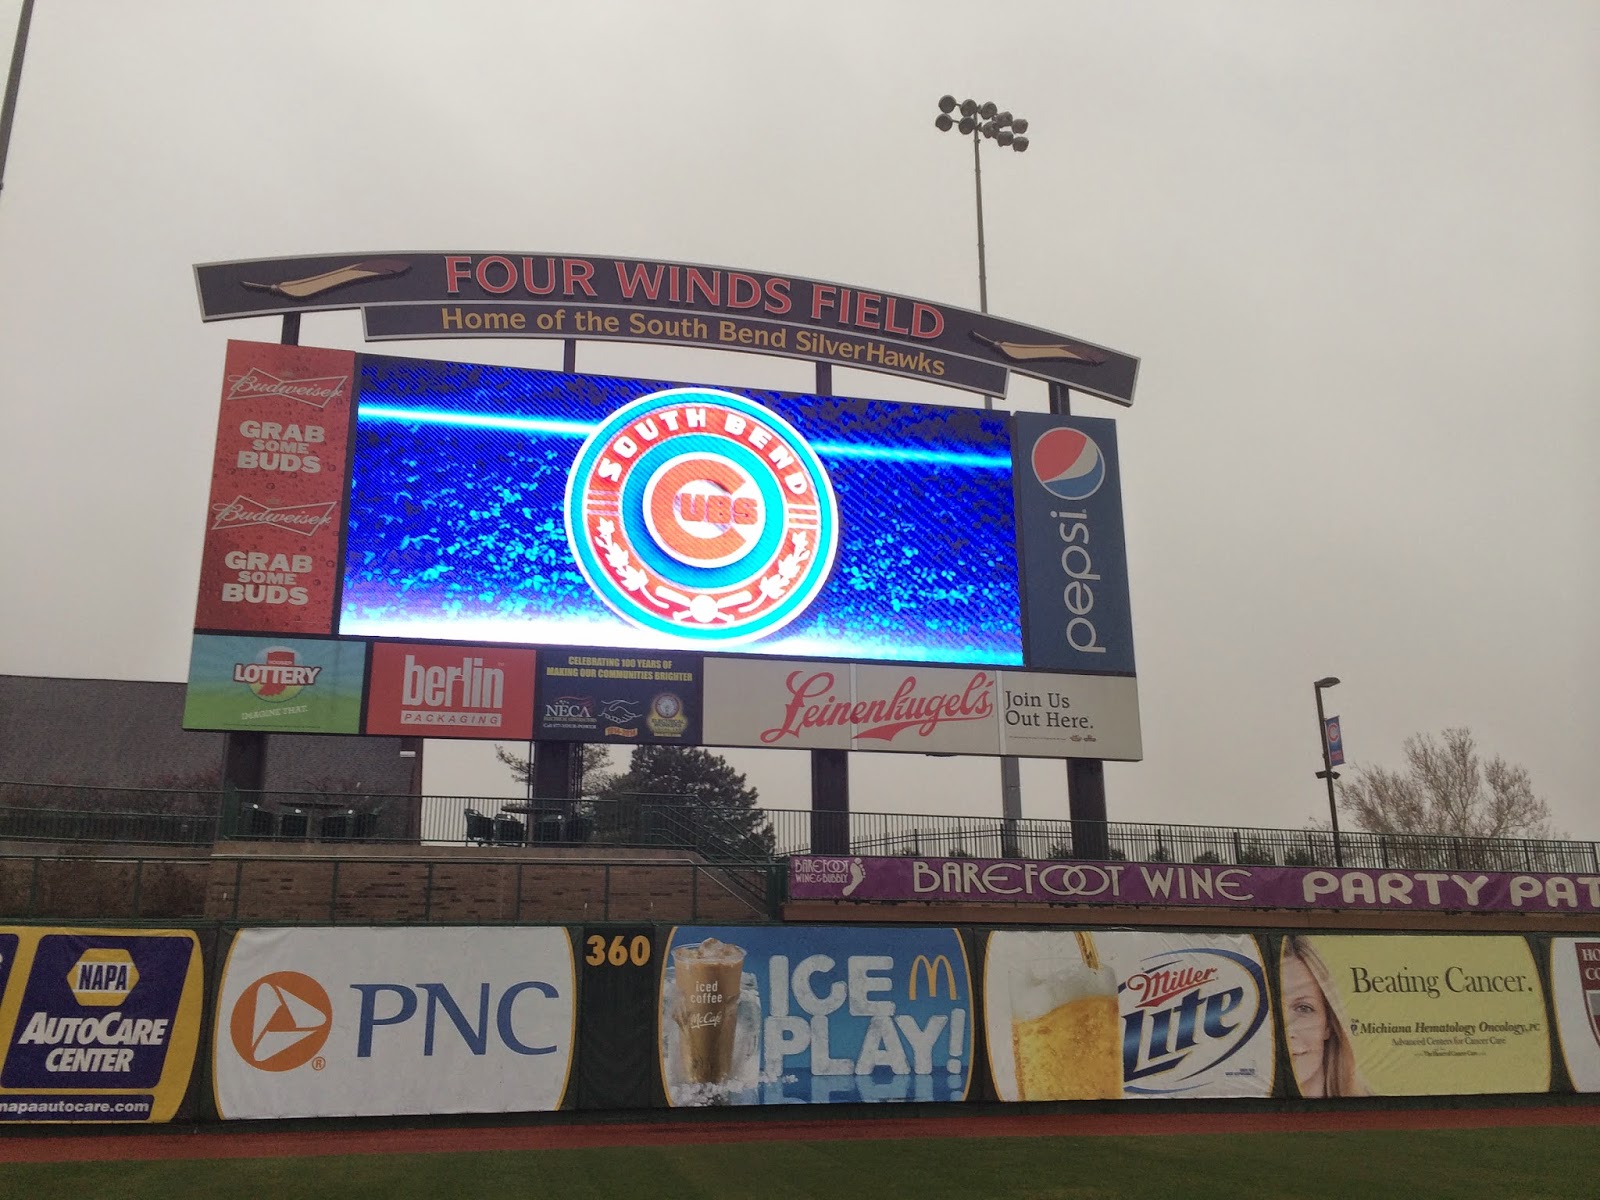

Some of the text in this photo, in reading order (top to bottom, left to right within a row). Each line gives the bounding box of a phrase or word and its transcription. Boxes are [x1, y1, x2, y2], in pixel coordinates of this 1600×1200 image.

[444, 255, 945, 339] FOUR WINDS FIELD
[441, 307, 945, 376] Home of the South Bend SilverHawks
[228, 375, 343, 398] Budweiser
[239, 420, 325, 443] GRAB
[252, 439, 309, 454] SOME
[597, 408, 808, 495] SOUTH BEND
[237, 451, 321, 474] BUDS
[212, 503, 331, 525] Budweiser
[224, 551, 313, 573] GRAB
[237, 571, 296, 586] SOME
[1050, 510, 1106, 653] pepsi
[221, 583, 309, 606] BUDS
[547, 667, 693, 681] MAKING OUR COMMUNITIES BRIGHTER
[568, 656, 672, 669] CELEBRATING 100 YEARS OF
[234, 664, 321, 685] LOTTERY
[402, 654, 504, 708] berlin
[545, 704, 591, 717] NECA
[760, 671, 994, 743] Leinenkugel's
[1005, 690, 1070, 710] Join Us
[404, 713, 499, 725] PACKAGING
[1005, 710, 1093, 728] Out Here.
[794, 859, 849, 873] BAREFOOT
[913, 861, 1254, 900] BAREFOOT WINE
[1302, 870, 1600, 907] PARTY PAT
[585, 935, 651, 967] 360
[78, 964, 127, 991] NAPA
[695, 980, 718, 992] iced
[769, 954, 896, 1016] ICE
[1127, 966, 1218, 1006] Miller
[1350, 966, 1533, 999] Beating Cancer.
[690, 993, 723, 1003] coffee
[350, 981, 560, 1058] PNC
[1360, 1023, 1412, 1034] Michiana
[1415, 1022, 1476, 1036] Hematology
[764, 1008, 966, 1076] PLAY!
[1121, 986, 1244, 1083] Lite
[1392, 1037, 1425, 1046] Advanced
[1465, 1036, 1488, 1045] Cancer
[1489, 1036, 1506, 1044] Care
[45, 1047, 135, 1072] CENTER
[0, 1100, 149, 1114] napaautocare.com
